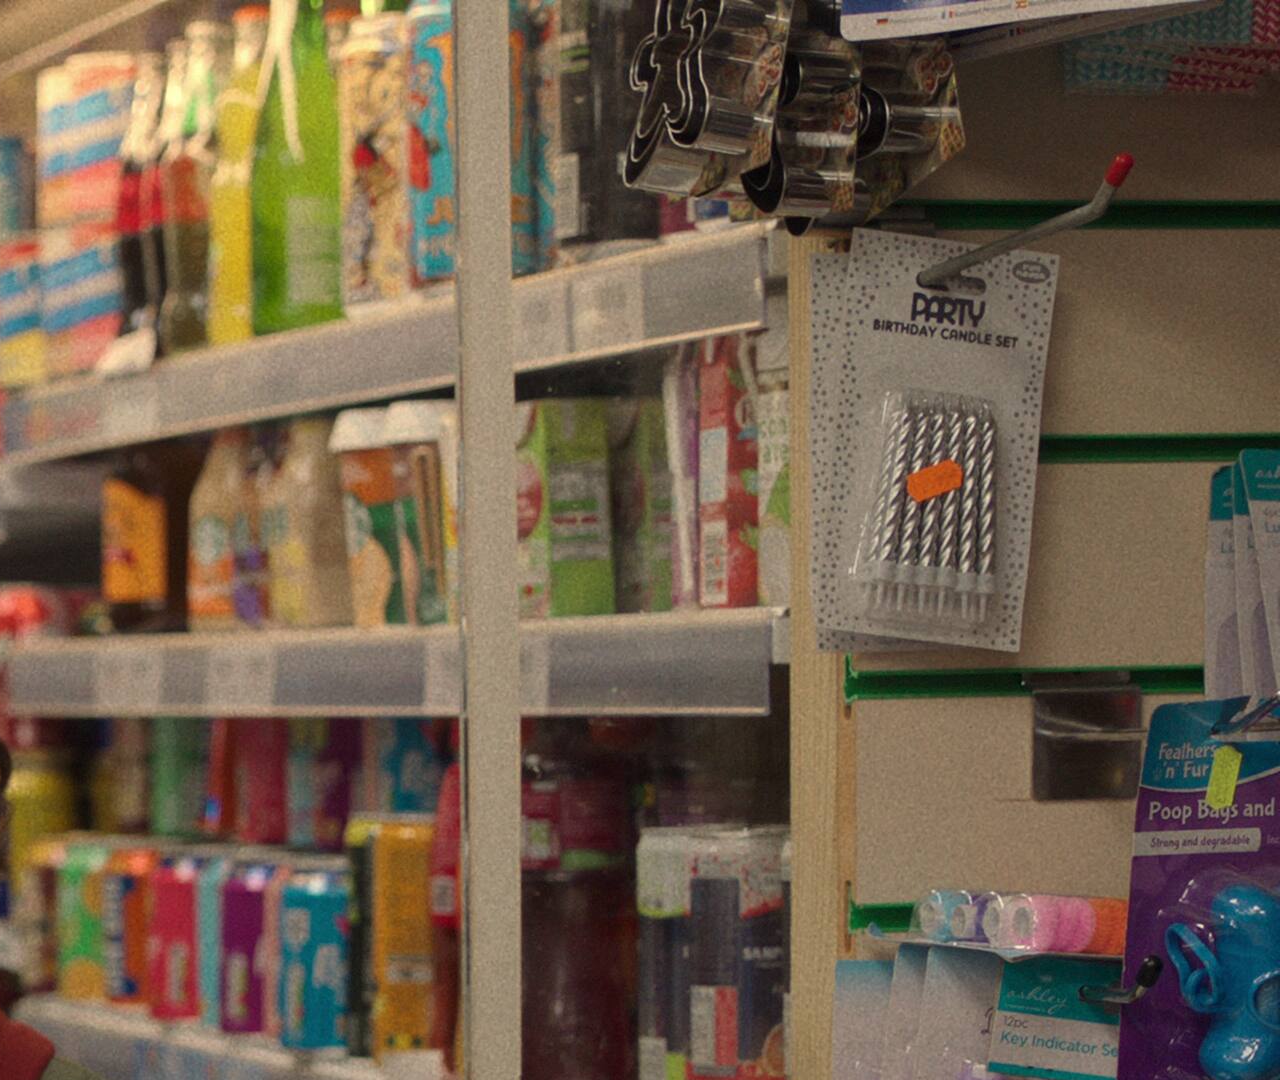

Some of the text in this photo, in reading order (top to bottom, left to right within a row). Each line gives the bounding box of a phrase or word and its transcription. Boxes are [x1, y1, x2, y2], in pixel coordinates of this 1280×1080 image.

[911, 292, 986, 327] PARTY
[873, 319, 1018, 348] BIRTHDAY CANDLE SET
[1159, 742, 1216, 760] Feathers
[1184, 761, 1209, 778] Fur
[1149, 797, 1276, 825] Poop Bags and
[1151, 834, 1250, 850] Strong and degradable
[1007, 986, 1067, 1015] ashley
[1000, 1031, 1029, 1048] Key
[1032, 1035, 1097, 1055] Indicator
